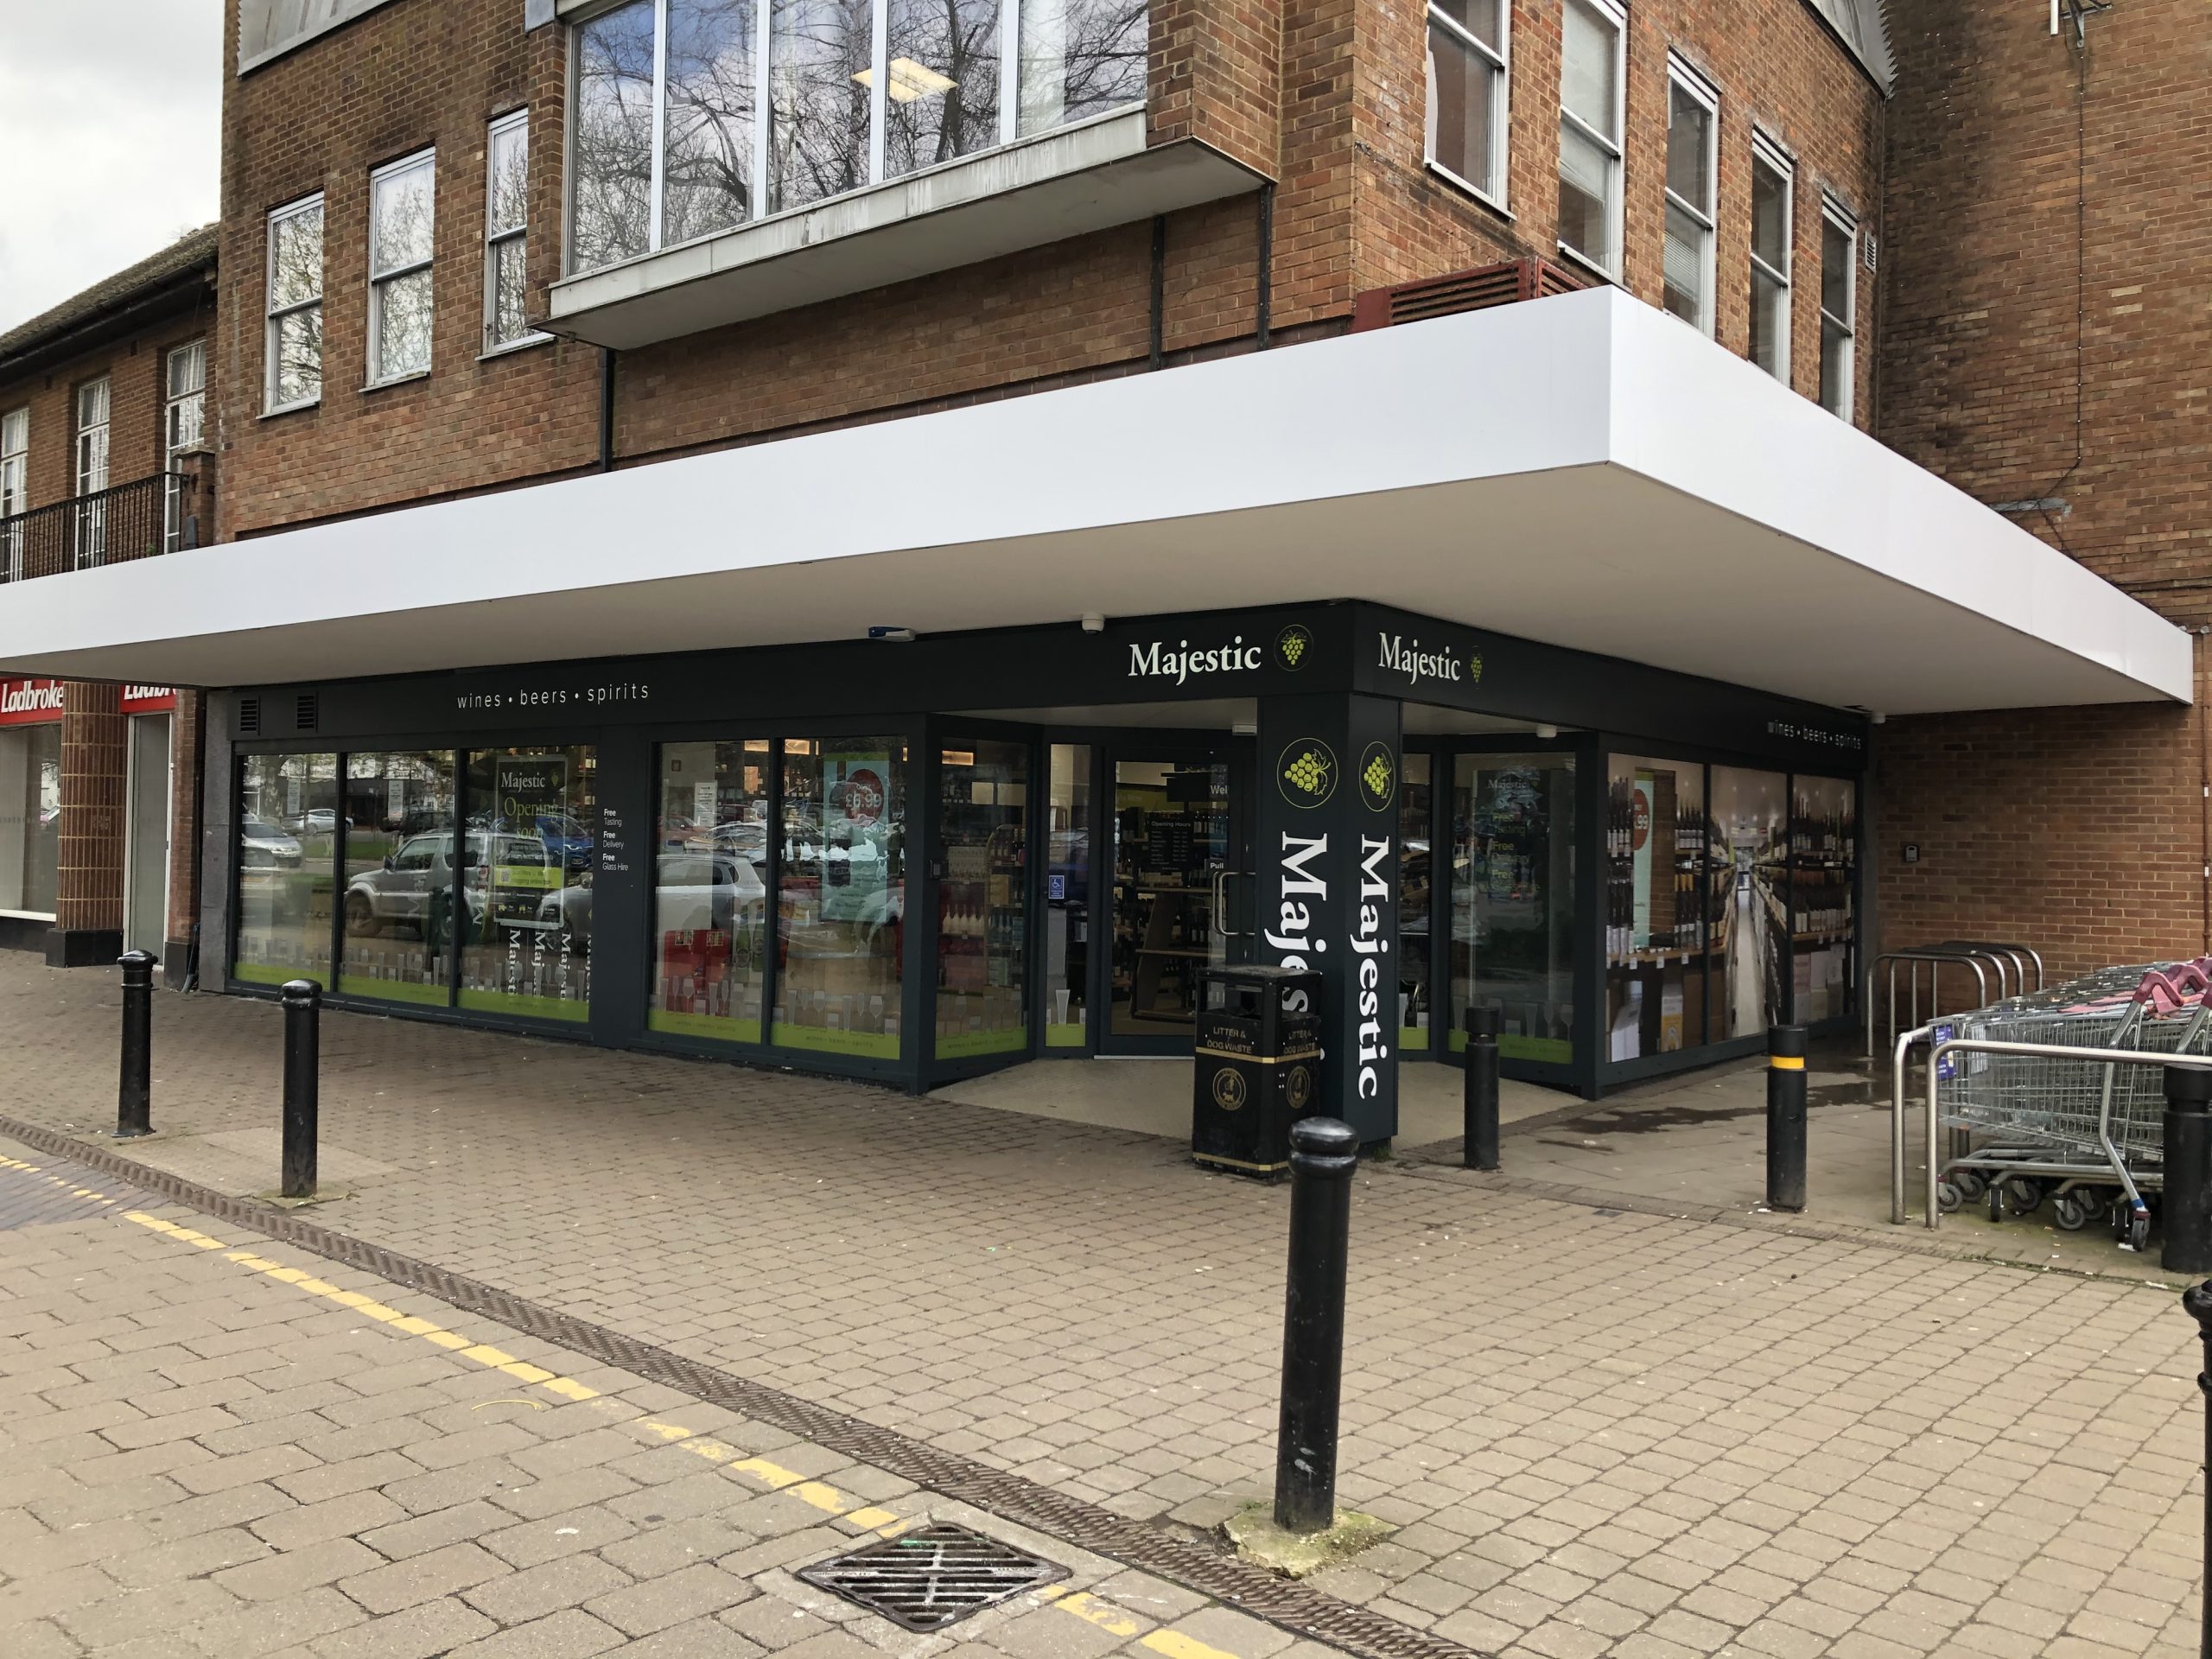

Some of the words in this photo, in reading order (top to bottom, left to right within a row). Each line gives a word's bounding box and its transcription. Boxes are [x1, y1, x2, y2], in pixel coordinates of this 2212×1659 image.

[1128, 635, 1262, 686] Majestic
[1377, 632, 1460, 685] Majestic
[457, 692, 501, 709] wines
[520, 689, 566, 705] beers
[588, 683, 648, 704] spirits
[1803, 724, 1827, 743] beers
[501, 772, 546, 792] Majestic
[1487, 779, 1528, 790] Majestic
[504, 797, 559, 823] Opening
[603, 808, 616, 817] Free
[604, 817, 622, 827] Tasting
[602, 839, 625, 849] Delivery
[1350, 833, 1389, 1099] Majestic
[1213, 1027, 1240, 1038] LITTER
[1206, 1039, 1224, 1050] DOG
[1224, 1042, 1252, 1054] WASTE
